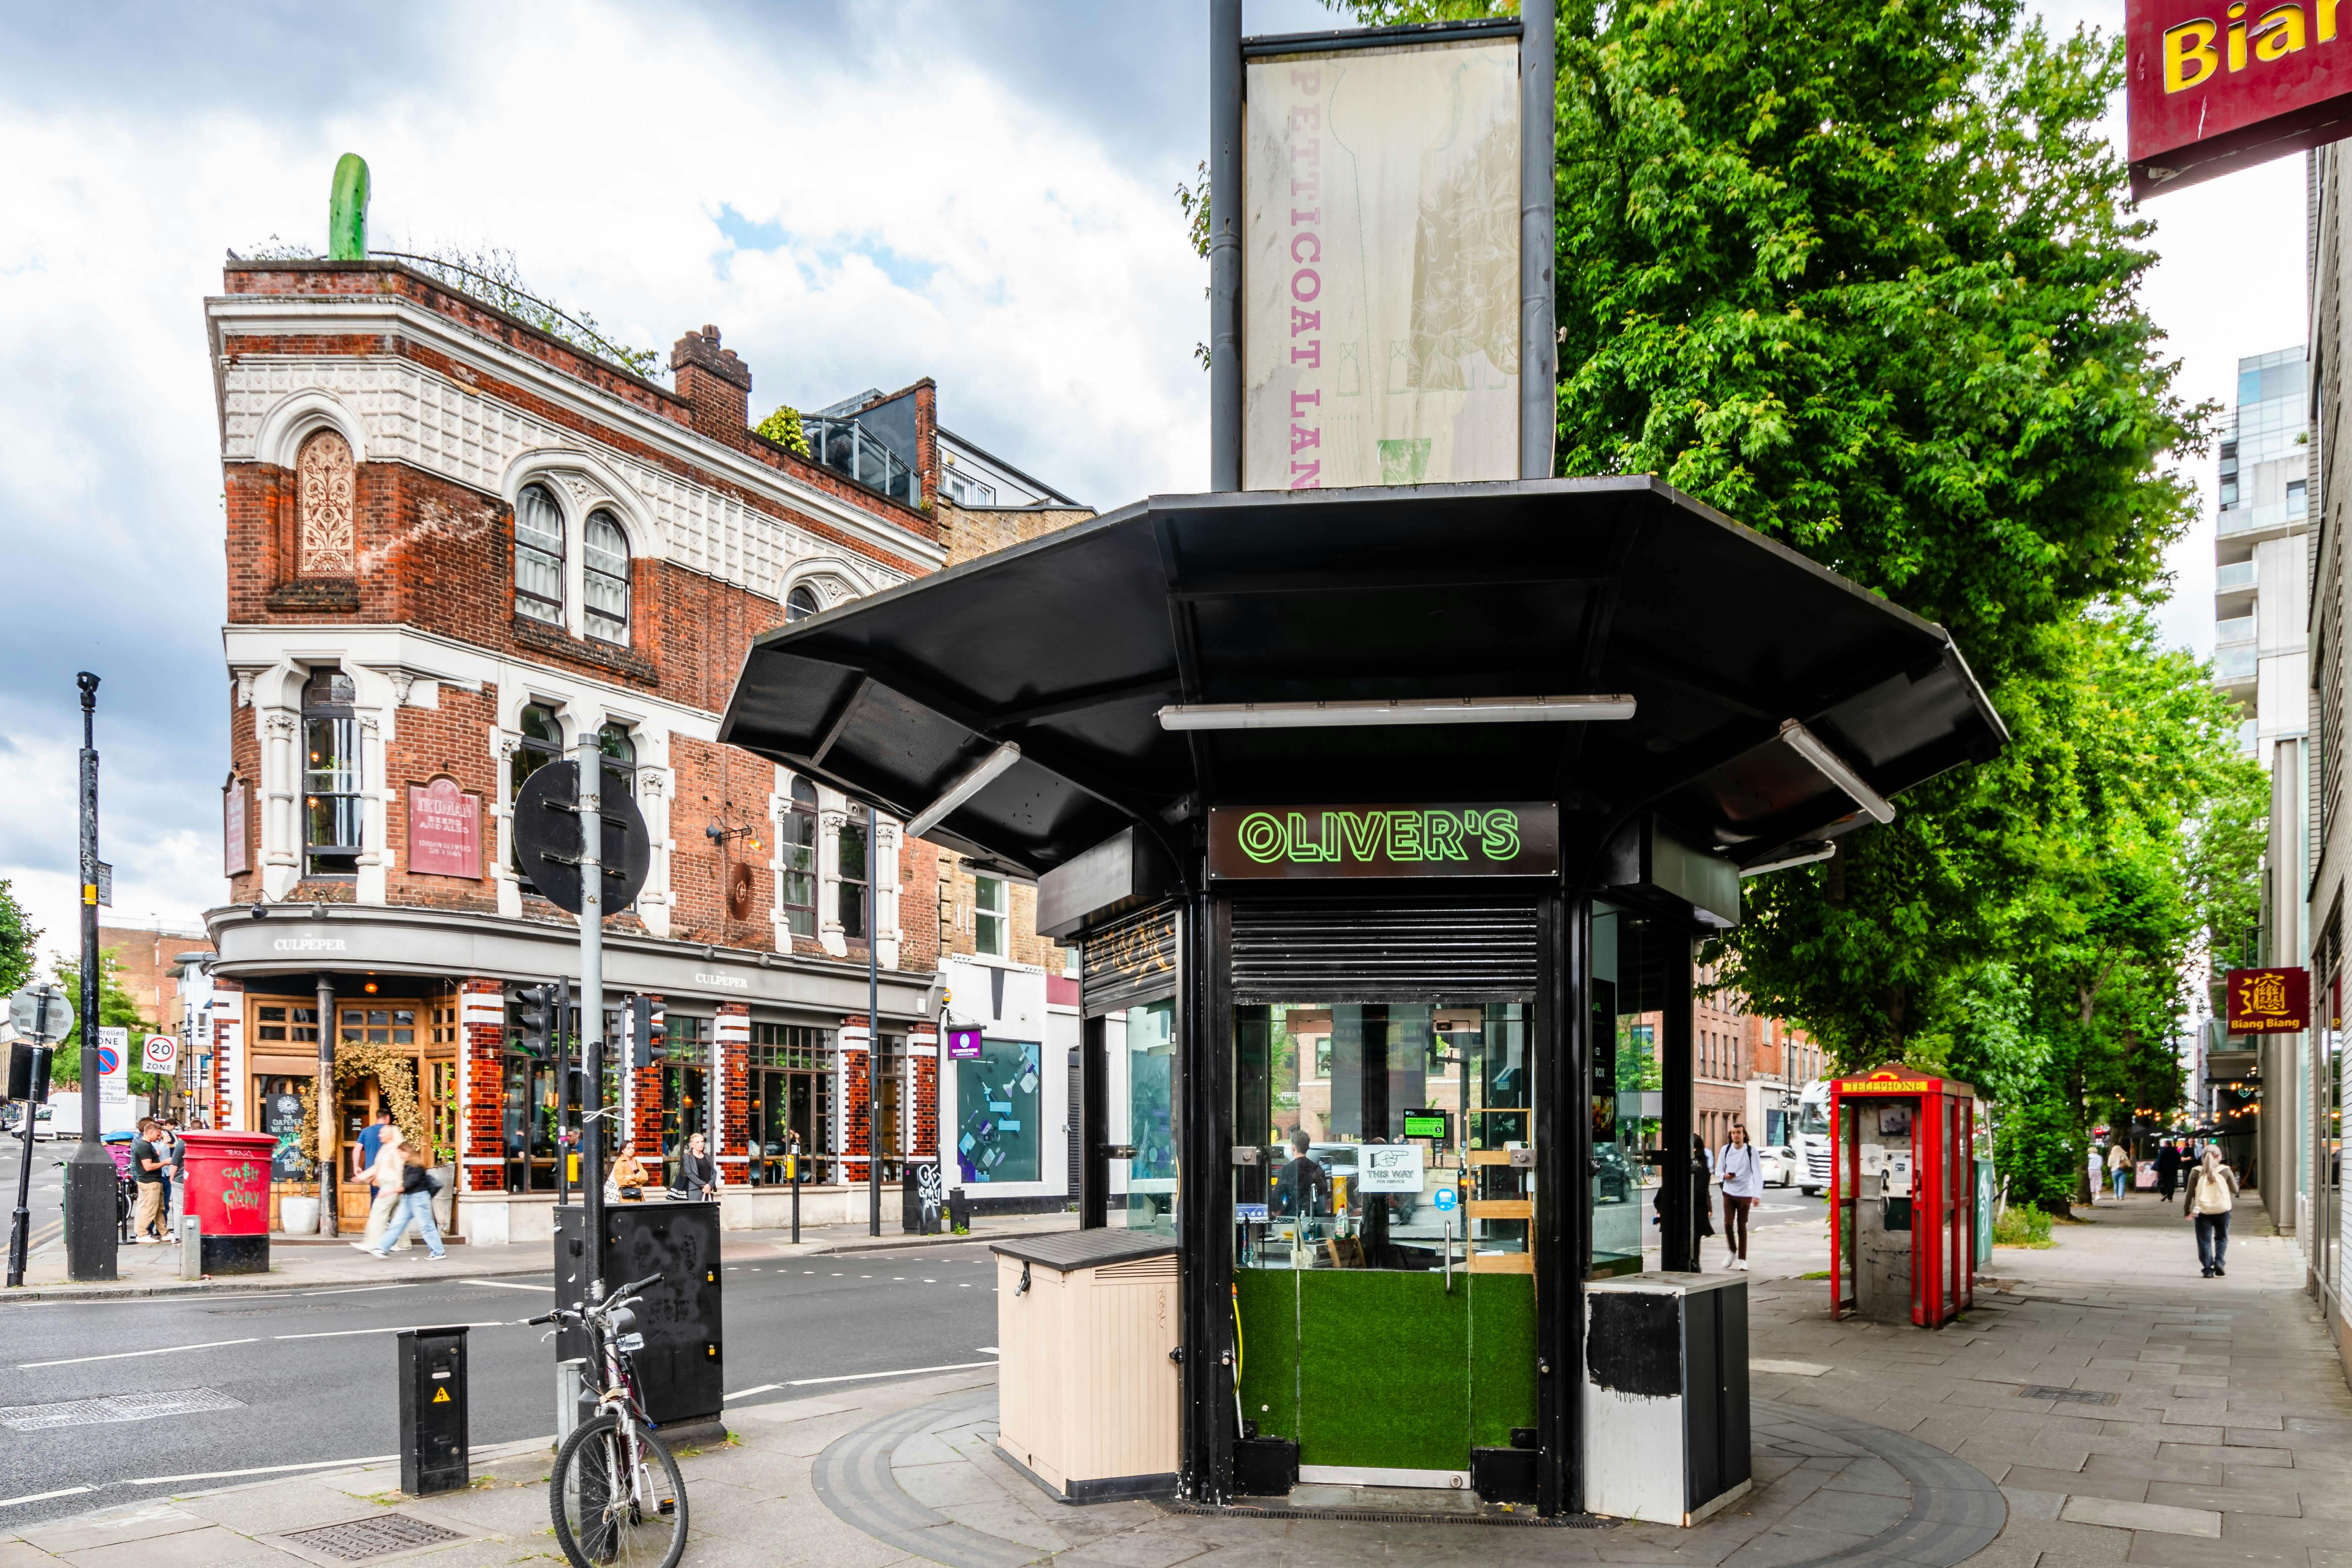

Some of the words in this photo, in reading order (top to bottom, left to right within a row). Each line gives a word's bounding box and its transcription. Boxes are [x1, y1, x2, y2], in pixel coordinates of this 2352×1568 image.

[2163, 0, 2342, 95] Bia
[1290, 69, 1321, 368] PETTICOAT
[1290, 389, 1321, 490] LAN
[427, 815, 462, 826] BEERS
[419, 821, 441, 829] AND
[443, 824, 469, 834] ALES
[1238, 809, 1520, 863] OLIVER'S
[274, 939, 347, 950] CULPEPER
[696, 973, 748, 988] CULPEPER
[2231, 1020, 2264, 1030] Biang
[2267, 1019, 2299, 1029] Biang
[152, 1044, 170, 1054] 20
[147, 1063, 172, 1071] ZONE
[1595, 1068, 1605, 1077] BOX
[1849, 1081, 1921, 1091] TELEPHONE
[1367, 1170, 1390, 1179] THIS
[1391, 1170, 1414, 1179] WAY
